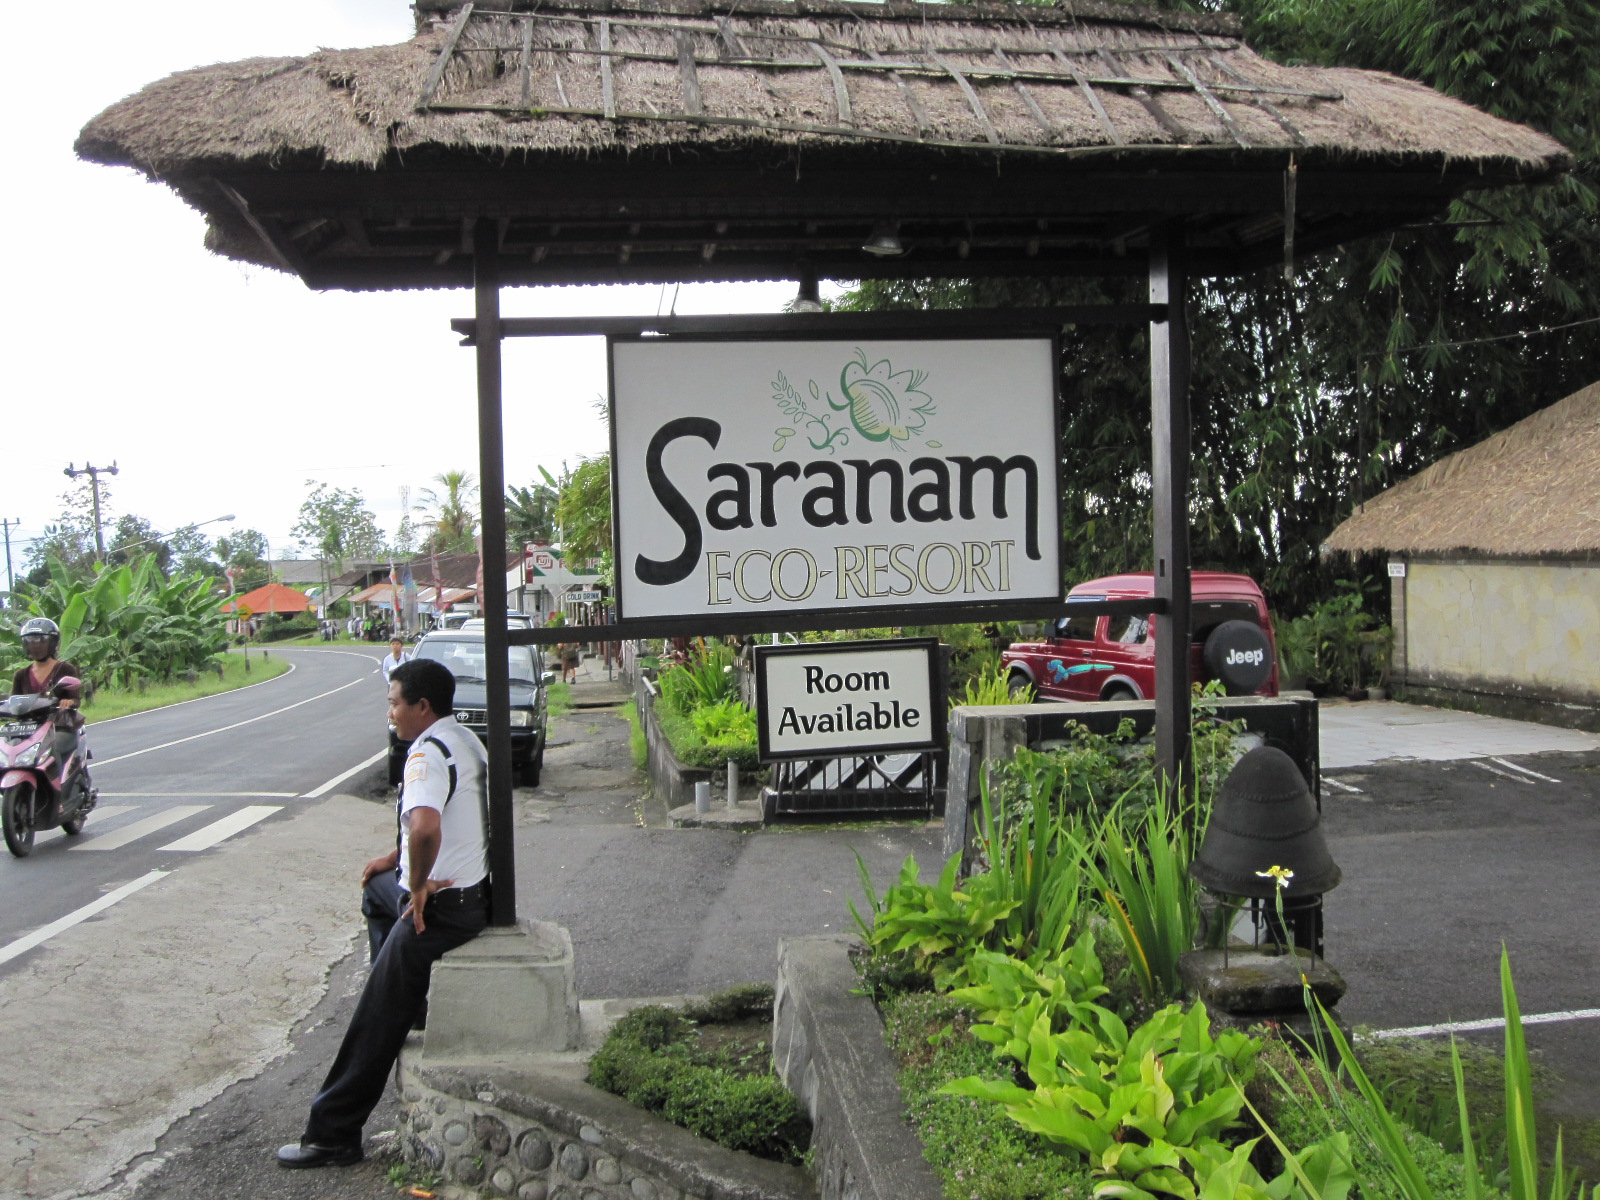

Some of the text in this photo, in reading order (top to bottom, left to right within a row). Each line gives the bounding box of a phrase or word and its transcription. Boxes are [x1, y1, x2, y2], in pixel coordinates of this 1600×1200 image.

[635, 416, 1041, 585] Saranam
[706, 540, 1015, 605] ECO-RESORT
[567, 592, 599, 601] COLD DRINK
[1226, 648, 1263, 667] Jeep
[803, 665, 890, 694] Room
[778, 700, 920, 736] Available
